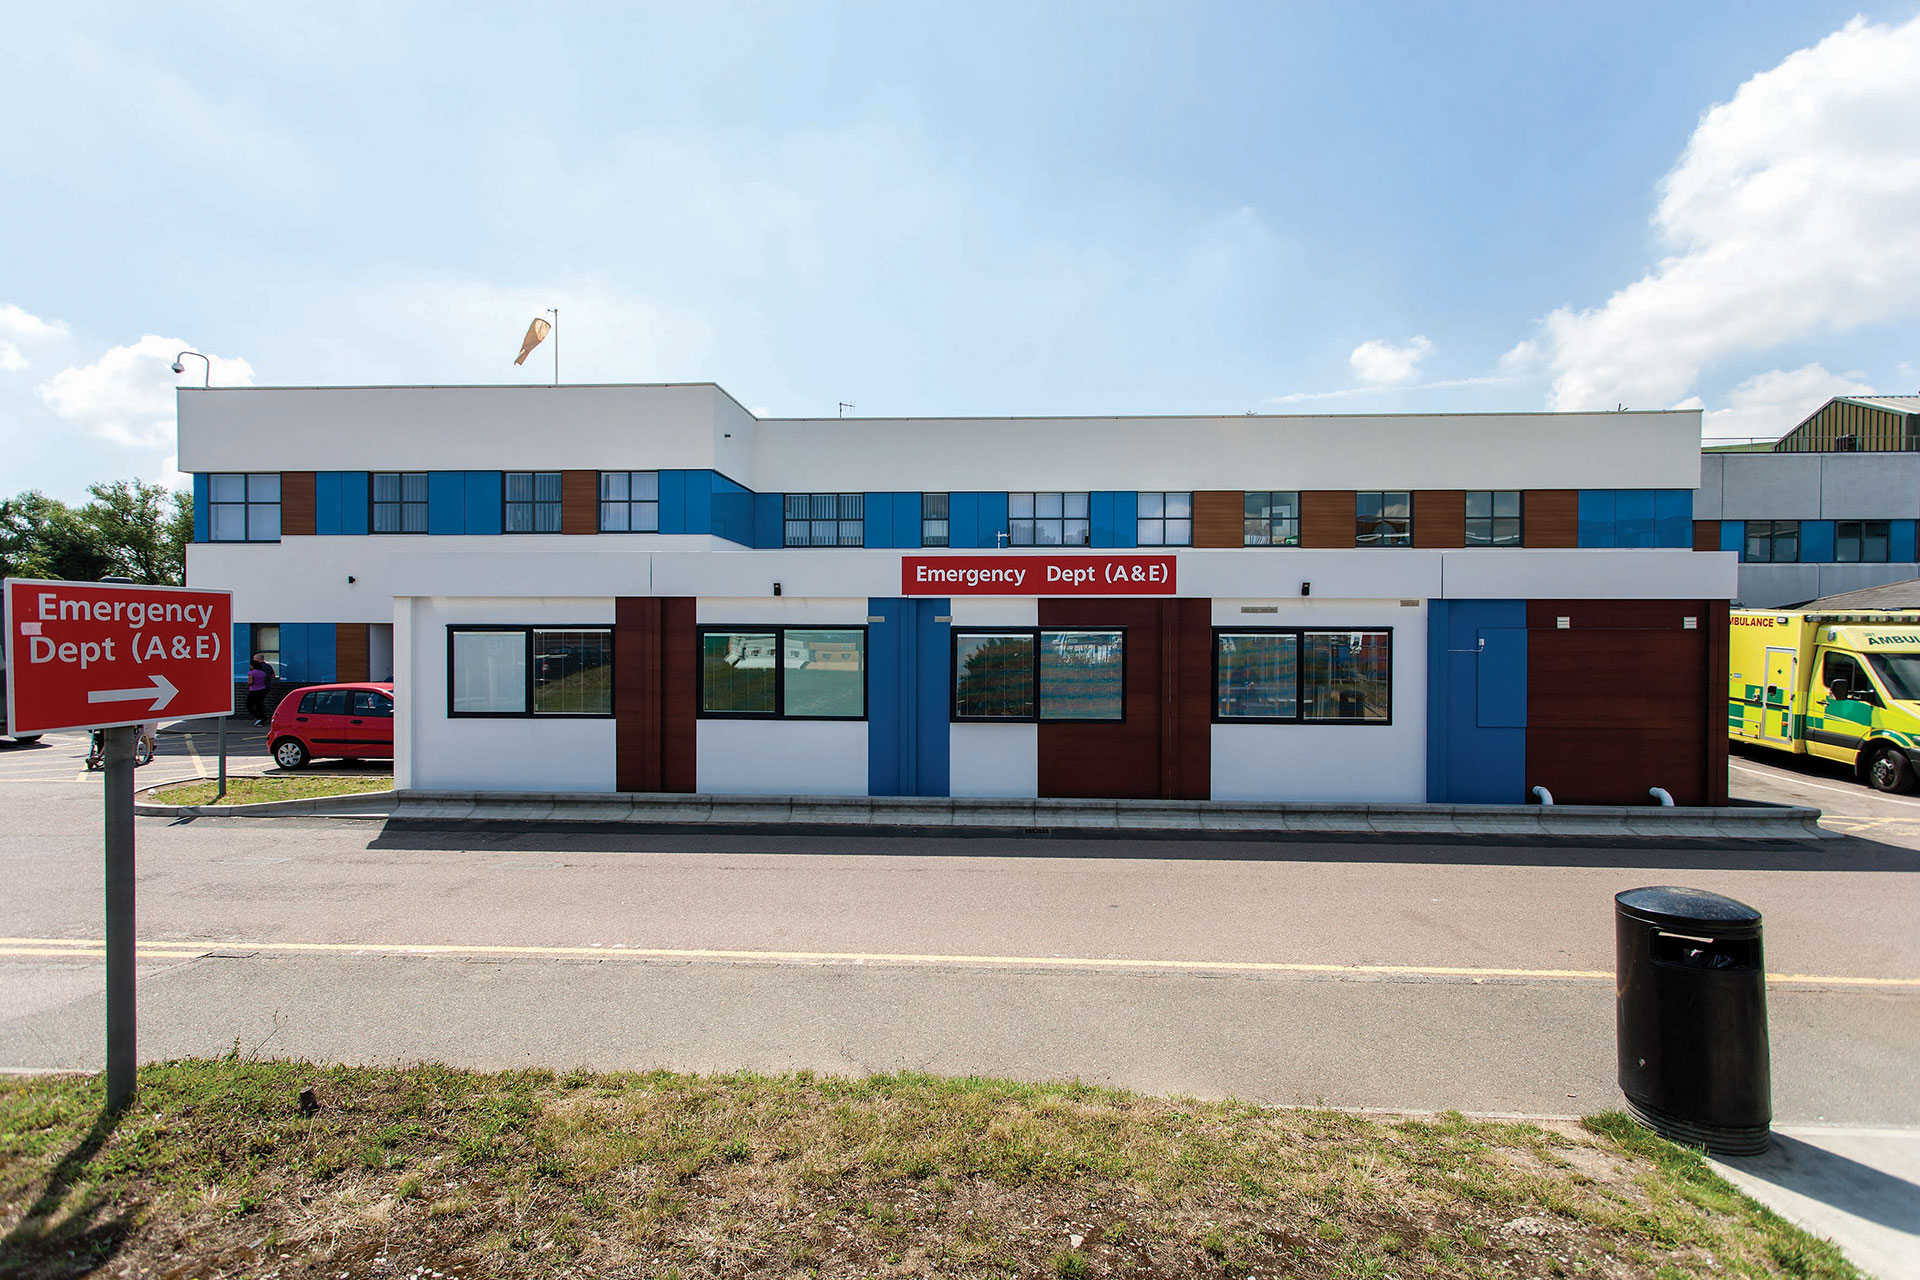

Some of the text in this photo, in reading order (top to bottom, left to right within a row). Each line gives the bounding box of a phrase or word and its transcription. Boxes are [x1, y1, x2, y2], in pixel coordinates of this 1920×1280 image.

[916, 563, 1169, 586] Emergency Dept (A&E)
[38, 593, 213, 629] Emergency
[30, 632, 221, 670] Dept (A&E)
